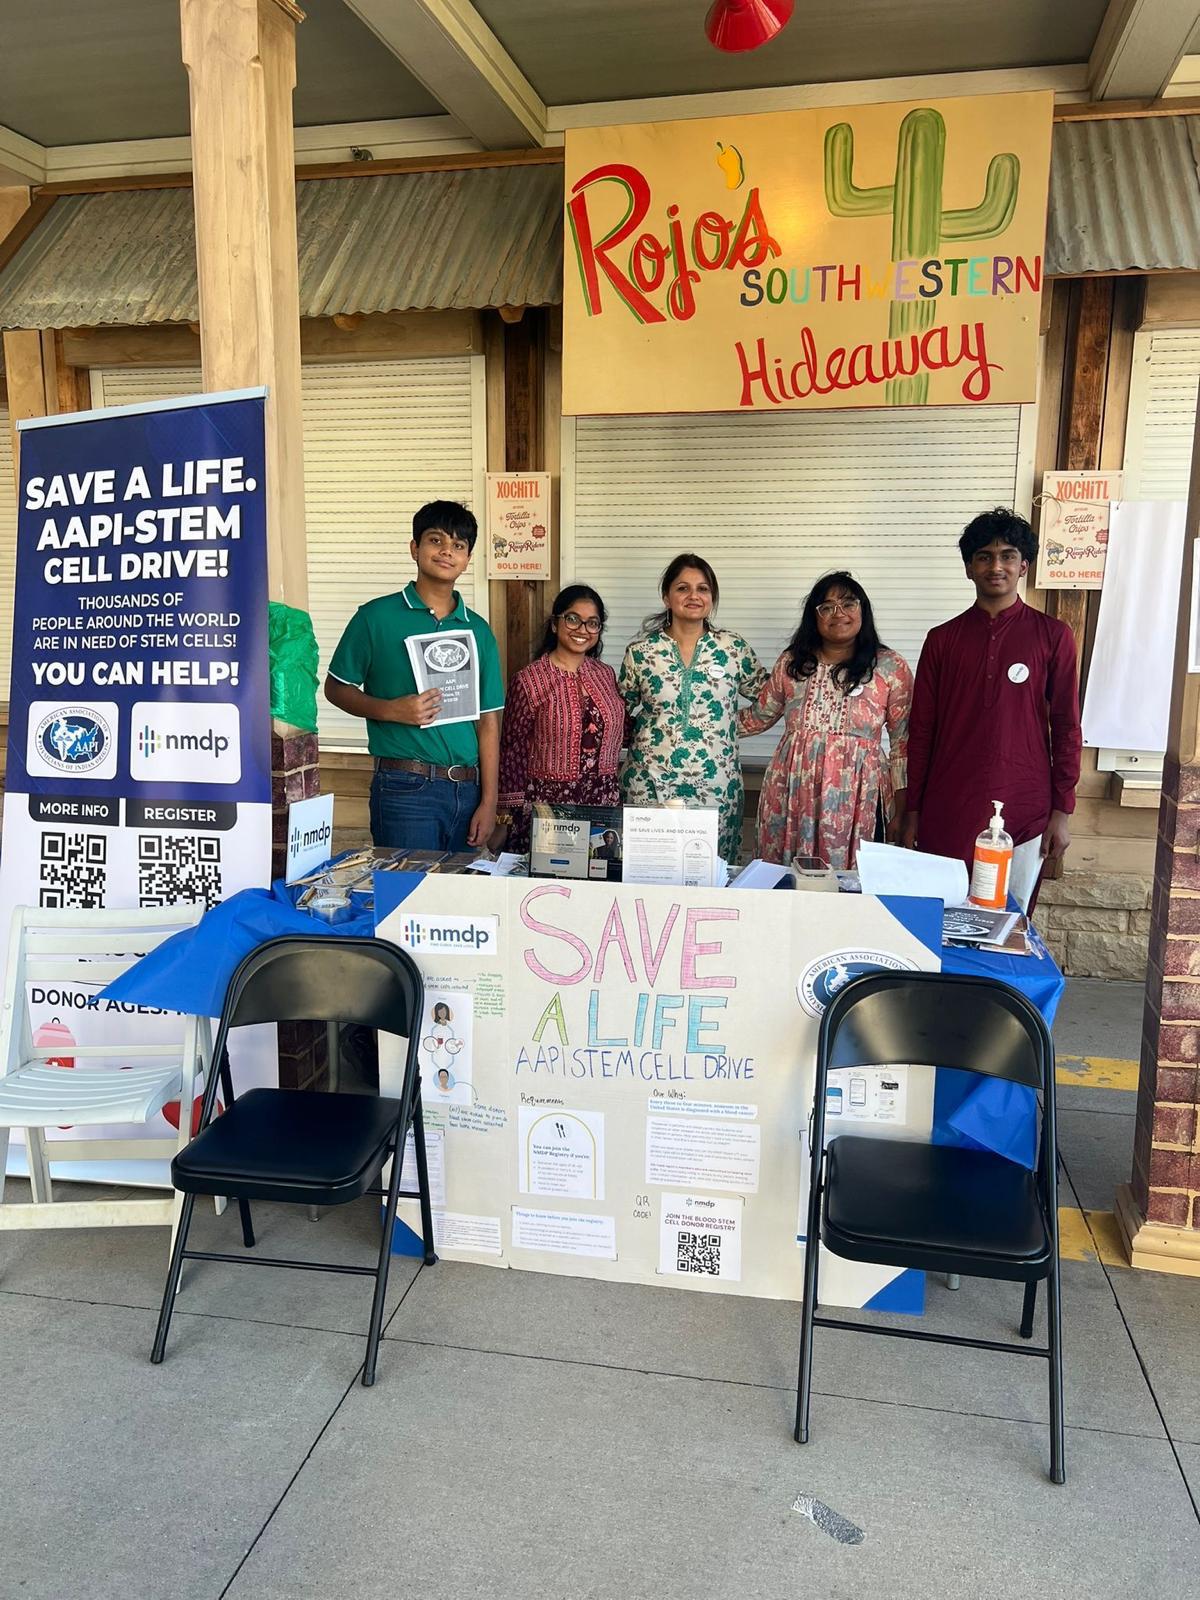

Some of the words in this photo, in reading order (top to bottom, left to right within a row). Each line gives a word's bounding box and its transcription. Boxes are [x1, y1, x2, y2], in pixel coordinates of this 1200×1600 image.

[740, 255, 1041, 308] SOUTHWESTERN
[734, 322, 1003, 406] Hideaway
[26, 470, 115, 510] SAVE
[124, 466, 151, 501] A
[162, 457, 257, 497] LIFE.
[37, 505, 241, 551] AAPI-STEM
[1065, 514, 1095, 524] Tortilla
[1069, 524, 1089, 534] Chips
[44, 556, 112, 584] CELL
[120, 550, 229, 581] DRIVE!
[78, 594, 159, 610] THOUSANDS
[163, 593, 184, 607] OF
[33, 617, 83, 630] PEOPLE
[87, 616, 143, 629] AROUND
[146, 614, 174, 628] THE
[178, 613, 240, 627] WORLD
[34, 637, 59, 650] ARE
[64, 636, 77, 649] IN
[82, 636, 116, 649] NEED
[119, 635, 138, 648] OF
[141, 634, 178, 648] STEM
[183, 633, 236, 648] CELLS!
[32, 662, 85, 686] YOU
[92, 661, 144, 685] CAN
[152, 661, 240, 686] HELP!
[41, 710, 67, 729] AMERICAN
[75, 742, 99, 752] AAPI
[166, 729, 229, 758] nmdp
[75, 762, 95, 770] INDIAN
[40, 802, 78, 816] MORE
[82, 805, 109, 818] INFO
[144, 808, 216, 822] REGISTER
[304, 821, 330, 846] nmdp
[554, 823, 580, 834] nmdp
[430, 924, 488, 948] nmdp
[520, 885, 739, 989] SAVE
[809, 955, 847, 976] AMERICAN
[32, 989, 98, 1011] DONOR
[532, 992, 568, 1045] A
[588, 990, 728, 1054] LIFE
[516, 1046, 565, 1075] AAPI
[571, 1049, 634, 1078] STEM
[640, 1052, 694, 1080] CELL
[705, 1055, 754, 1079] DRIVE
[668, 1089, 686, 1099] Why:
[636, 1195, 649, 1207] QR
[695, 1200, 715, 1208] nmdp
